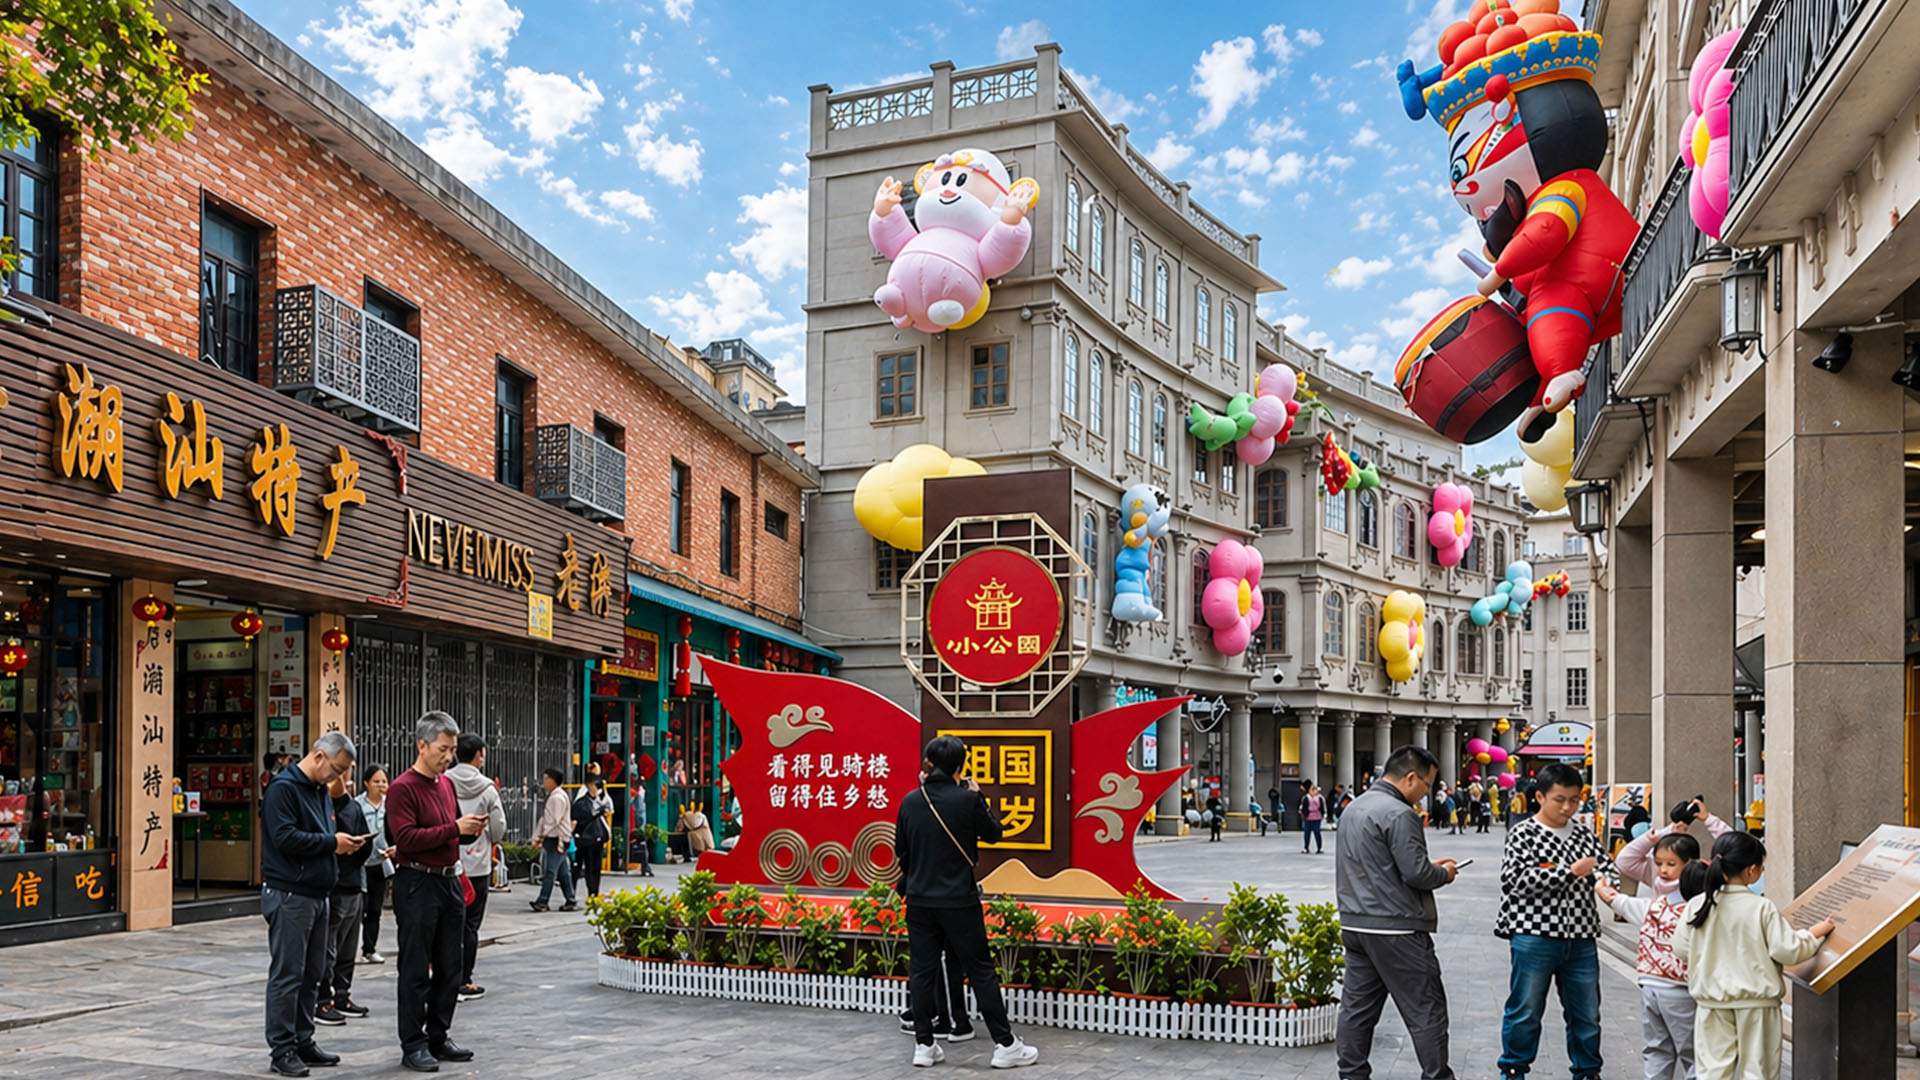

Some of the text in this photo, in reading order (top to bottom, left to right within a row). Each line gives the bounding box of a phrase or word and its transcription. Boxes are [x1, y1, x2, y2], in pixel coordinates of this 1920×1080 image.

[0, 362, 367, 560] 潮汕特产
[766, 752, 891, 779] 看得见骑楼
[768, 783, 889, 810] 留得住乡愁
[985, 795, 1036, 839] 岁
